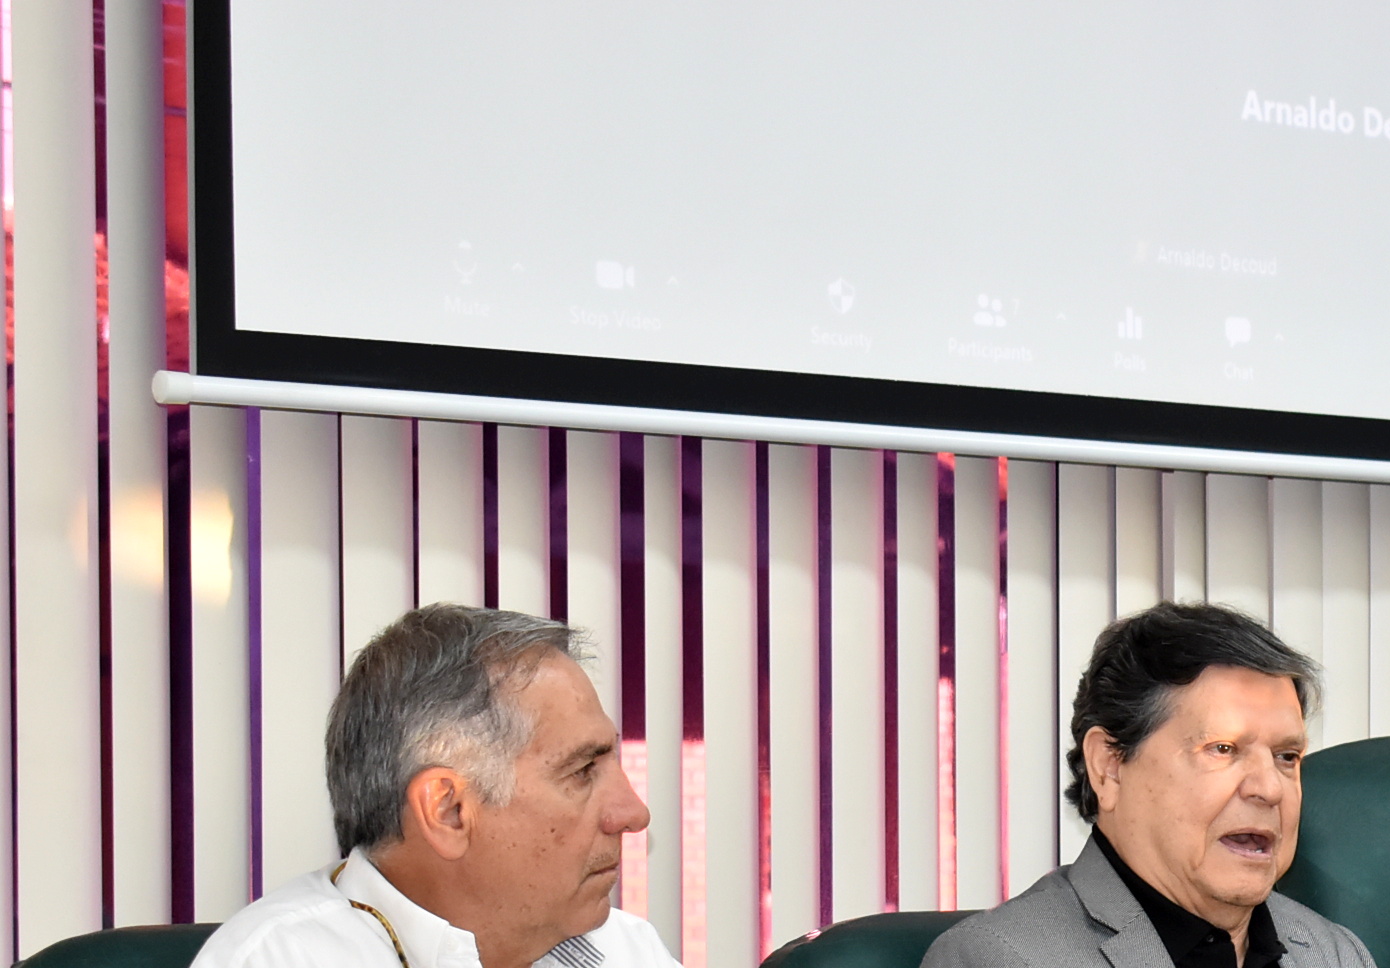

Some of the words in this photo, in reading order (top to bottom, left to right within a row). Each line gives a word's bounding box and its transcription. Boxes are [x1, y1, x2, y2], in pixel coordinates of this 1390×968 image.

[1241, 89, 1355, 135] Arnaldo
[1157, 245, 1215, 270] Arnaldo
[1220, 252, 1278, 276] Decoud
[811, 325, 873, 354] Security
[948, 336, 1034, 363] Participants
